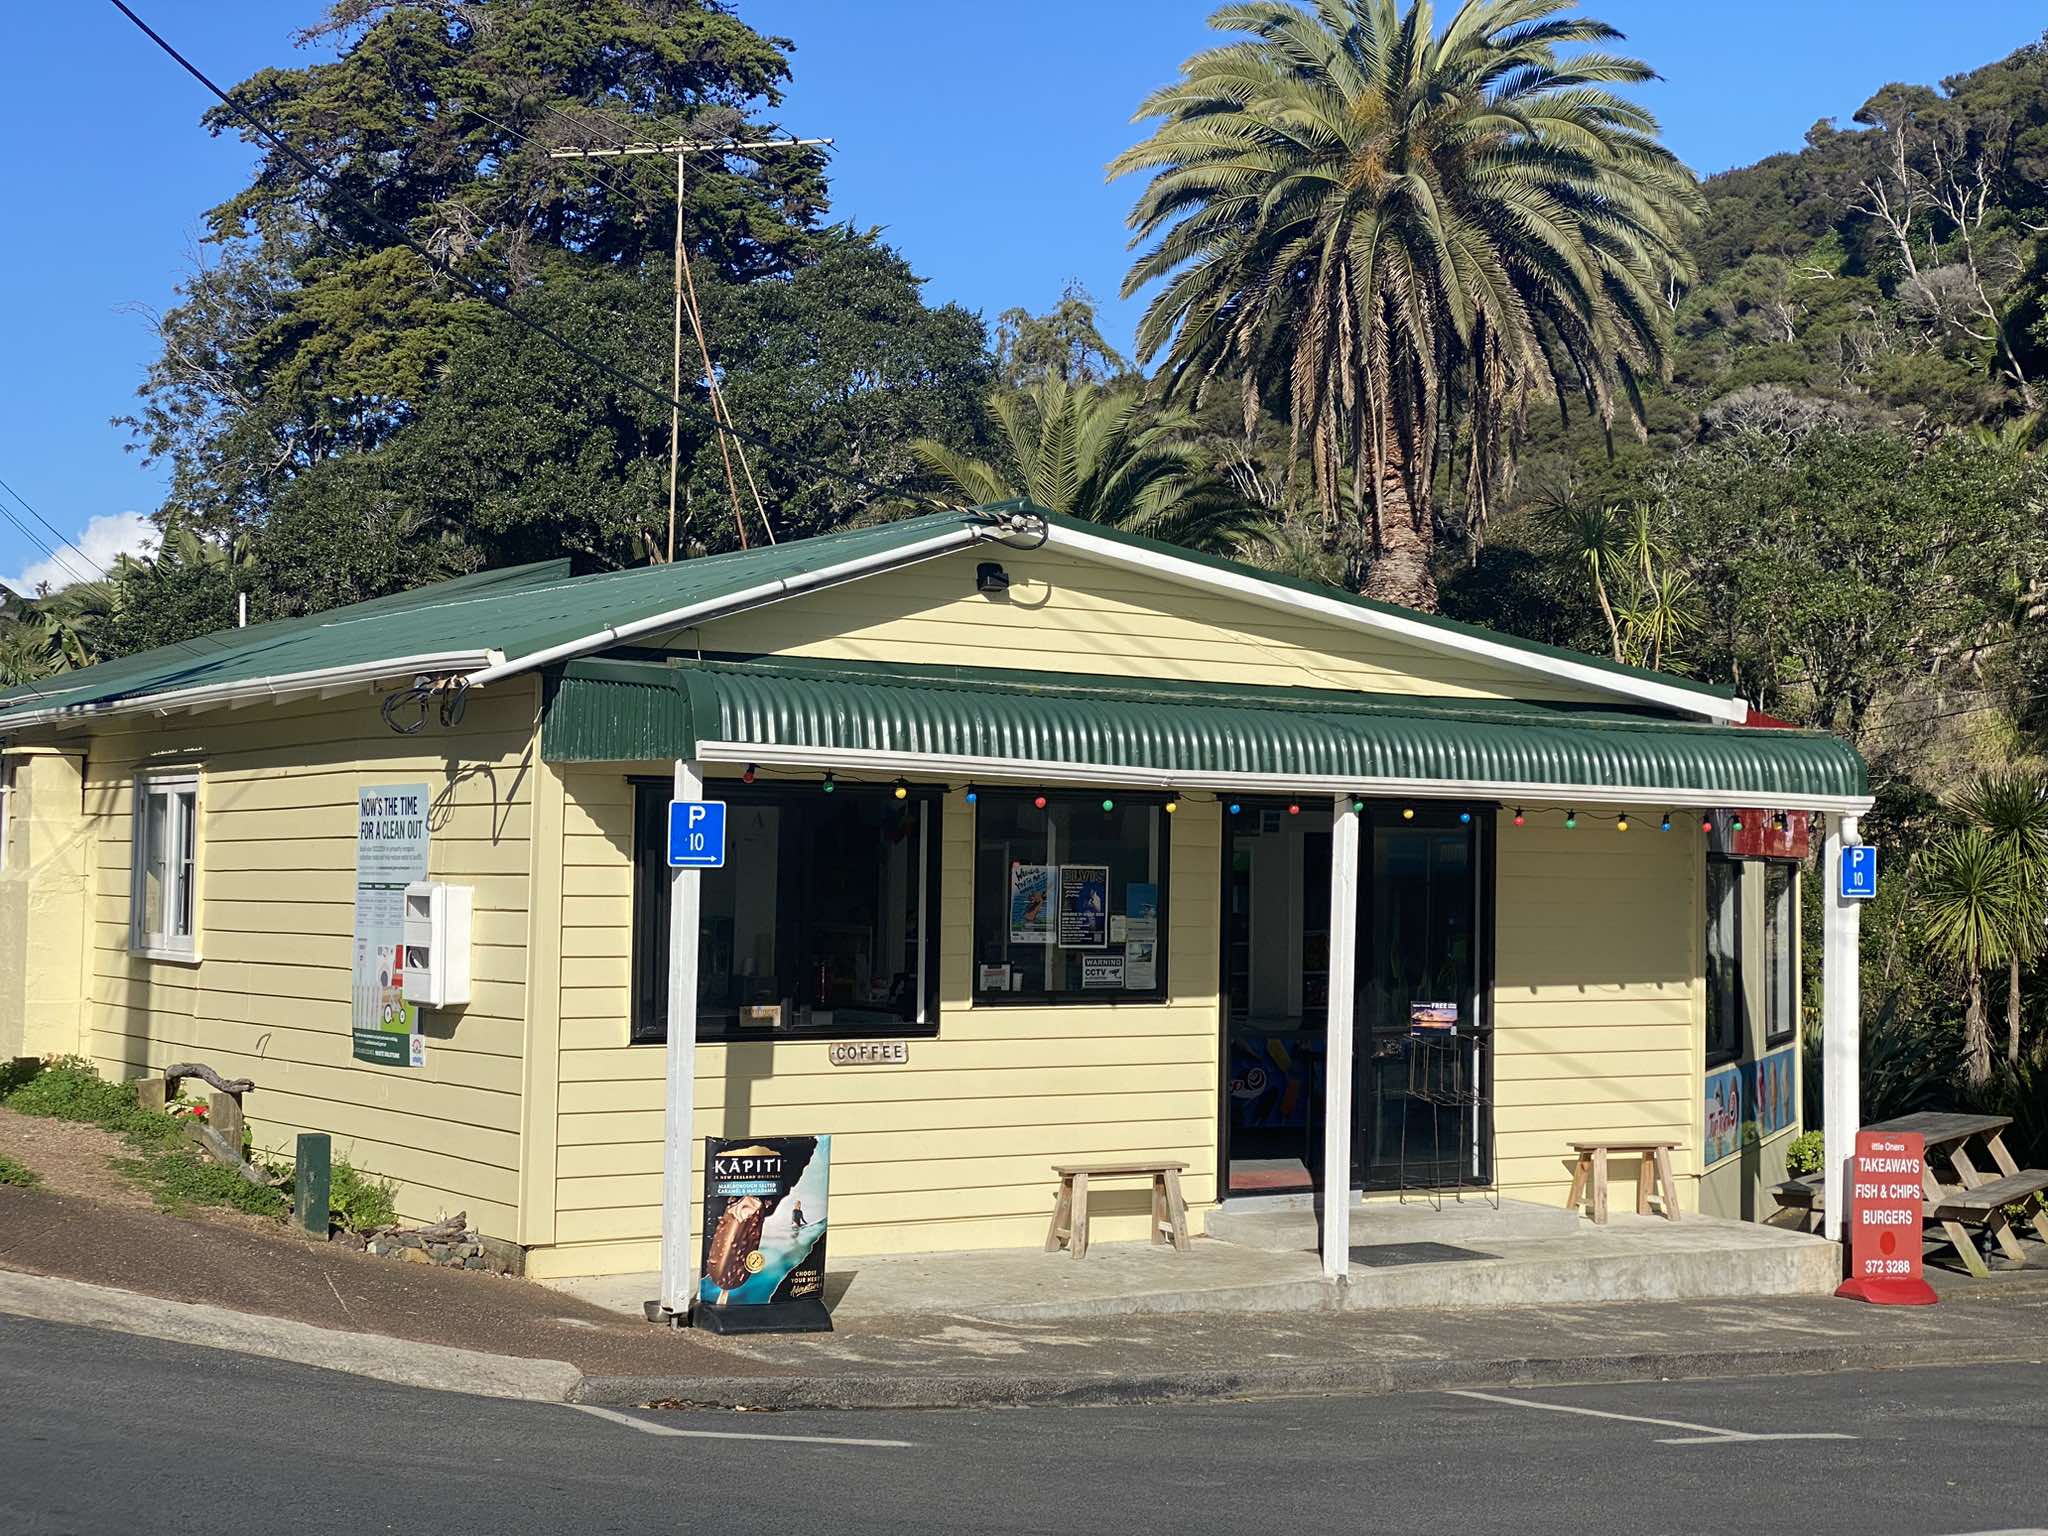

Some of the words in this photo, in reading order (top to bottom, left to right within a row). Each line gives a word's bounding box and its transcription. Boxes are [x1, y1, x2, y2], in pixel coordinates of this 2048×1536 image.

[361, 797, 382, 816] NOW'S
[384, 797, 398, 816] THE
[400, 796, 418, 815] TIME
[688, 805, 706, 829] P
[361, 821, 374, 840] FOR
[376, 821, 381, 840] A
[382, 820, 405, 840] CLEAN
[407, 820, 423, 839] OUT
[689, 832, 704, 851] 10
[1853, 849, 1865, 868] P
[1854, 872, 1864, 886] 10
[1085, 968, 1106, 976] CCTV
[836, 1045, 902, 1060] COFFEE
[714, 1158, 781, 1174] KĀPITI
[1859, 1157, 1920, 1174] TAKEAWAYS
[1855, 1184, 1878, 1198] FISH
[1880, 1184, 1888, 1198] &
[1890, 1184, 1920, 1199] CHIPS
[1863, 1210, 1912, 1225] BURGERS
[1865, 1260, 1883, 1273] 372
[1886, 1260, 1910, 1273] 3288
